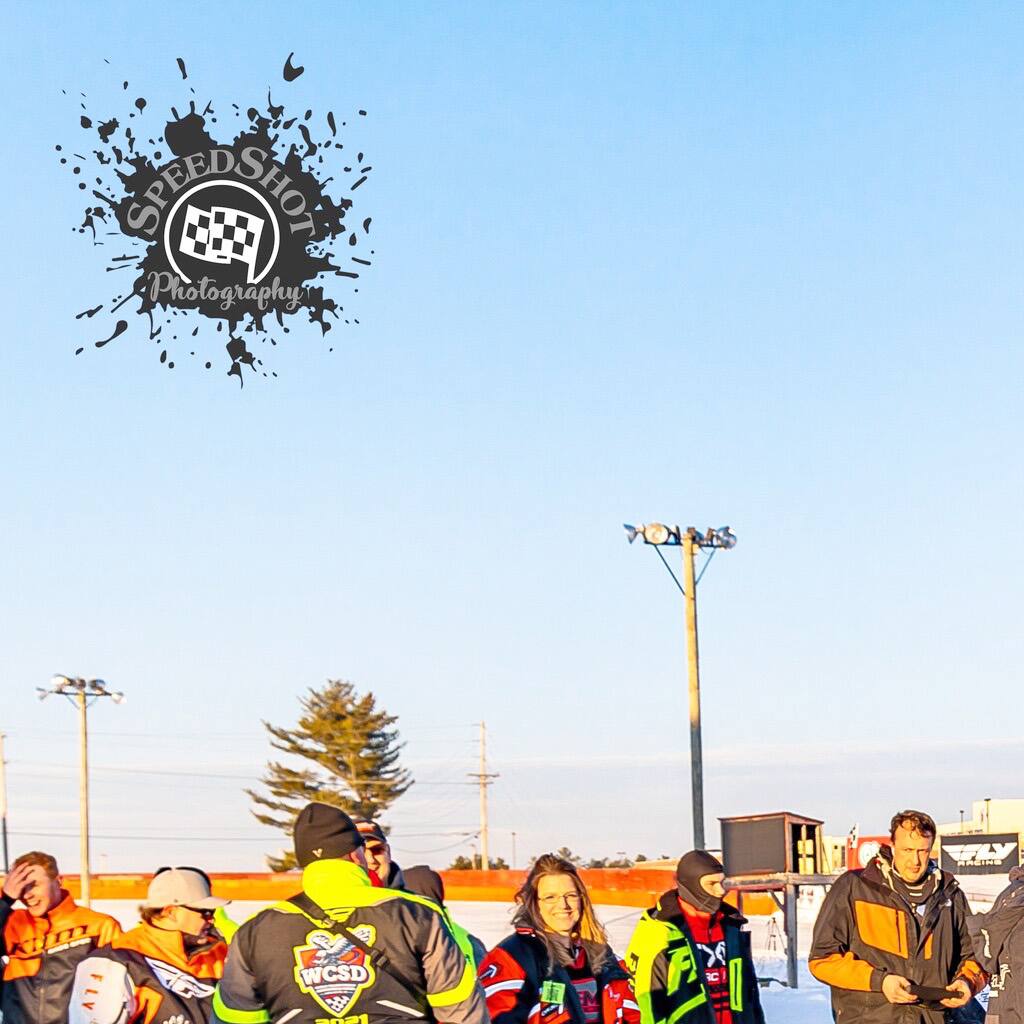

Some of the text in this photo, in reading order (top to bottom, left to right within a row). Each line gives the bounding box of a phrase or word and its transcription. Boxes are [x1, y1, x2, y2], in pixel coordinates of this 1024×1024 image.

[945, 842, 1018, 862] FLY
[957, 859, 1002, 867] RACING
[300, 963, 369, 987] WCSD
